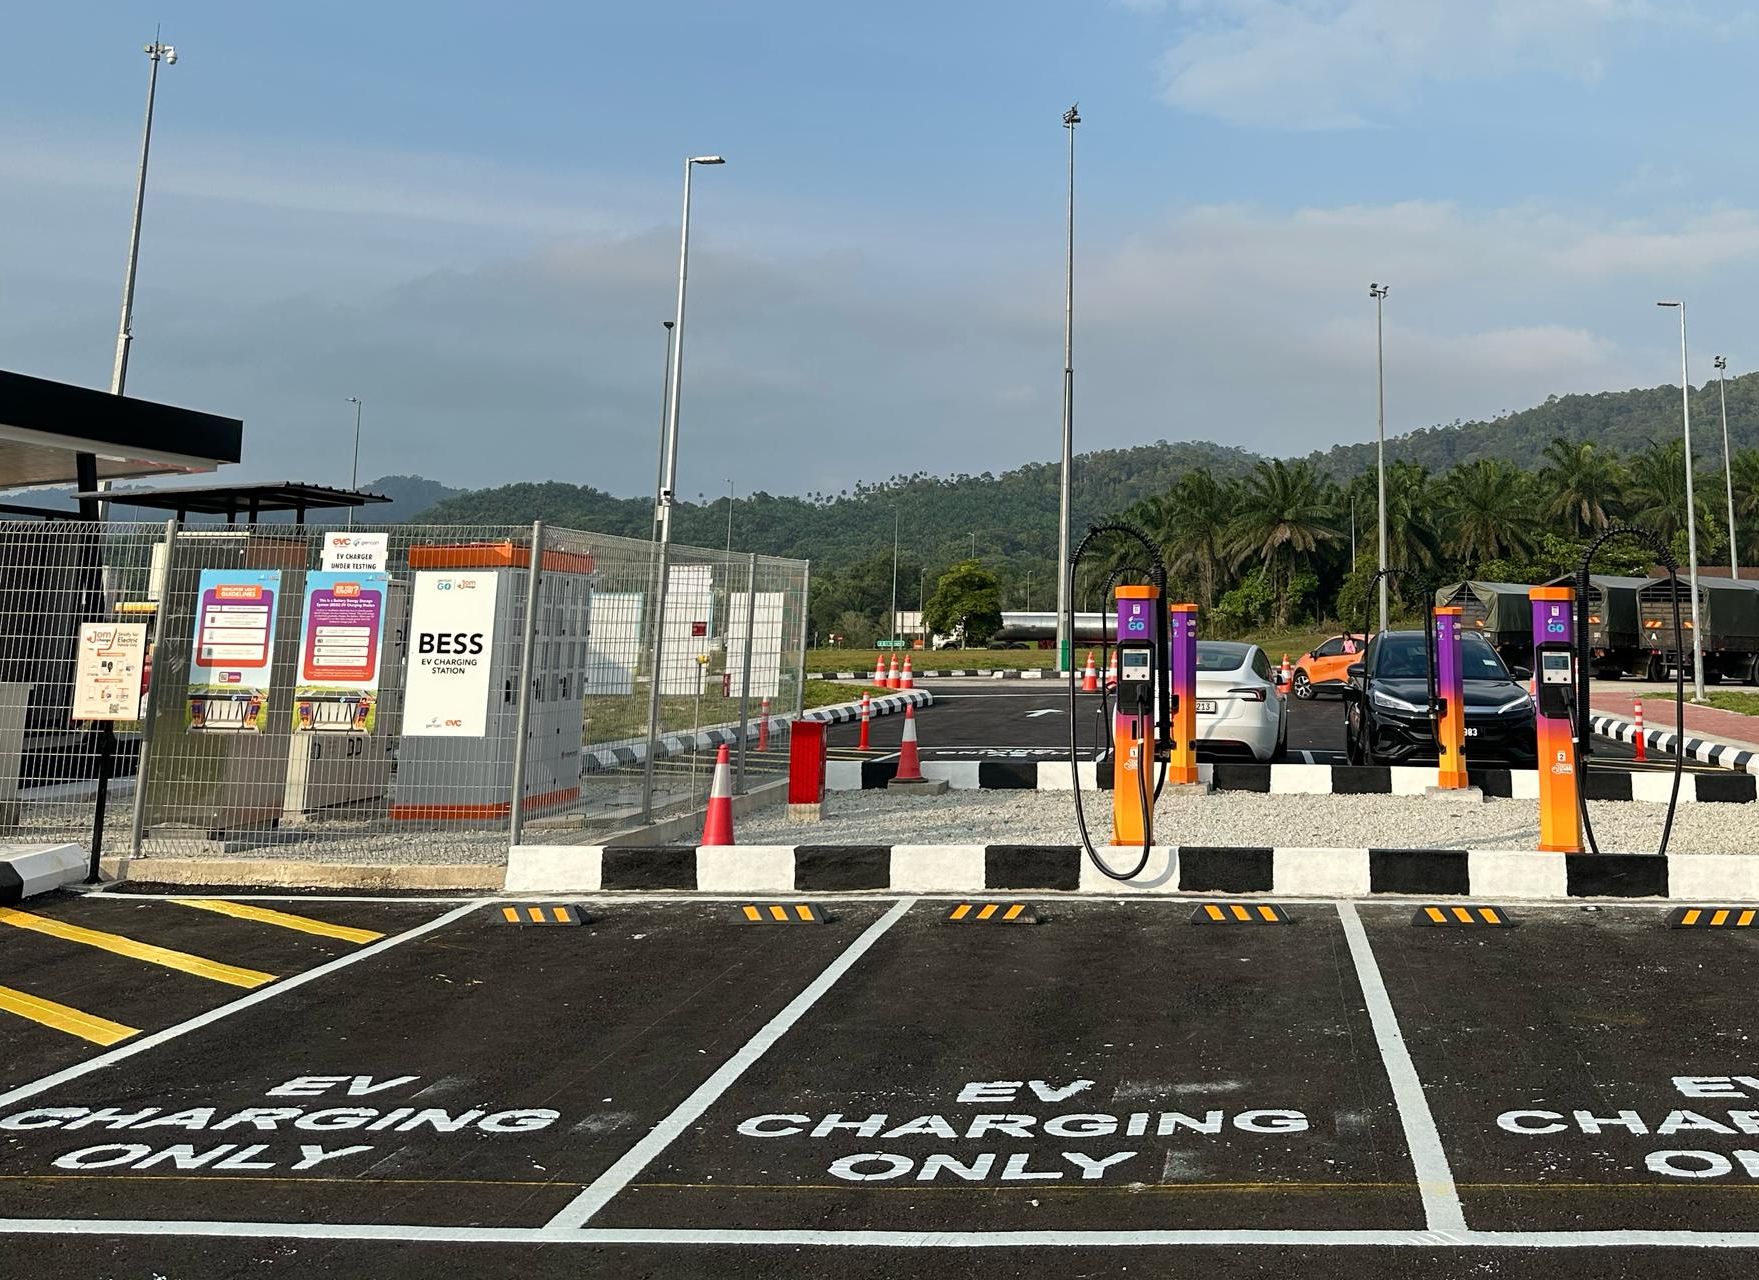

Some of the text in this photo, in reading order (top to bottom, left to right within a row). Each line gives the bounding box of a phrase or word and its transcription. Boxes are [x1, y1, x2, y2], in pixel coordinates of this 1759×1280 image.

[1128, 622, 1144, 631] GO
[1548, 624, 1565, 633] GO
[1650, 633, 1658, 641] A
[418, 633, 482, 654] BESS
[266, 1076, 420, 1096] EV
[956, 1080, 1095, 1102] EV
[0, 1107, 560, 1132] CHARGING
[737, 1110, 1309, 1138] CHARGING
[51, 1144, 374, 1169] ONLY
[827, 1152, 1137, 1180] ONLY
